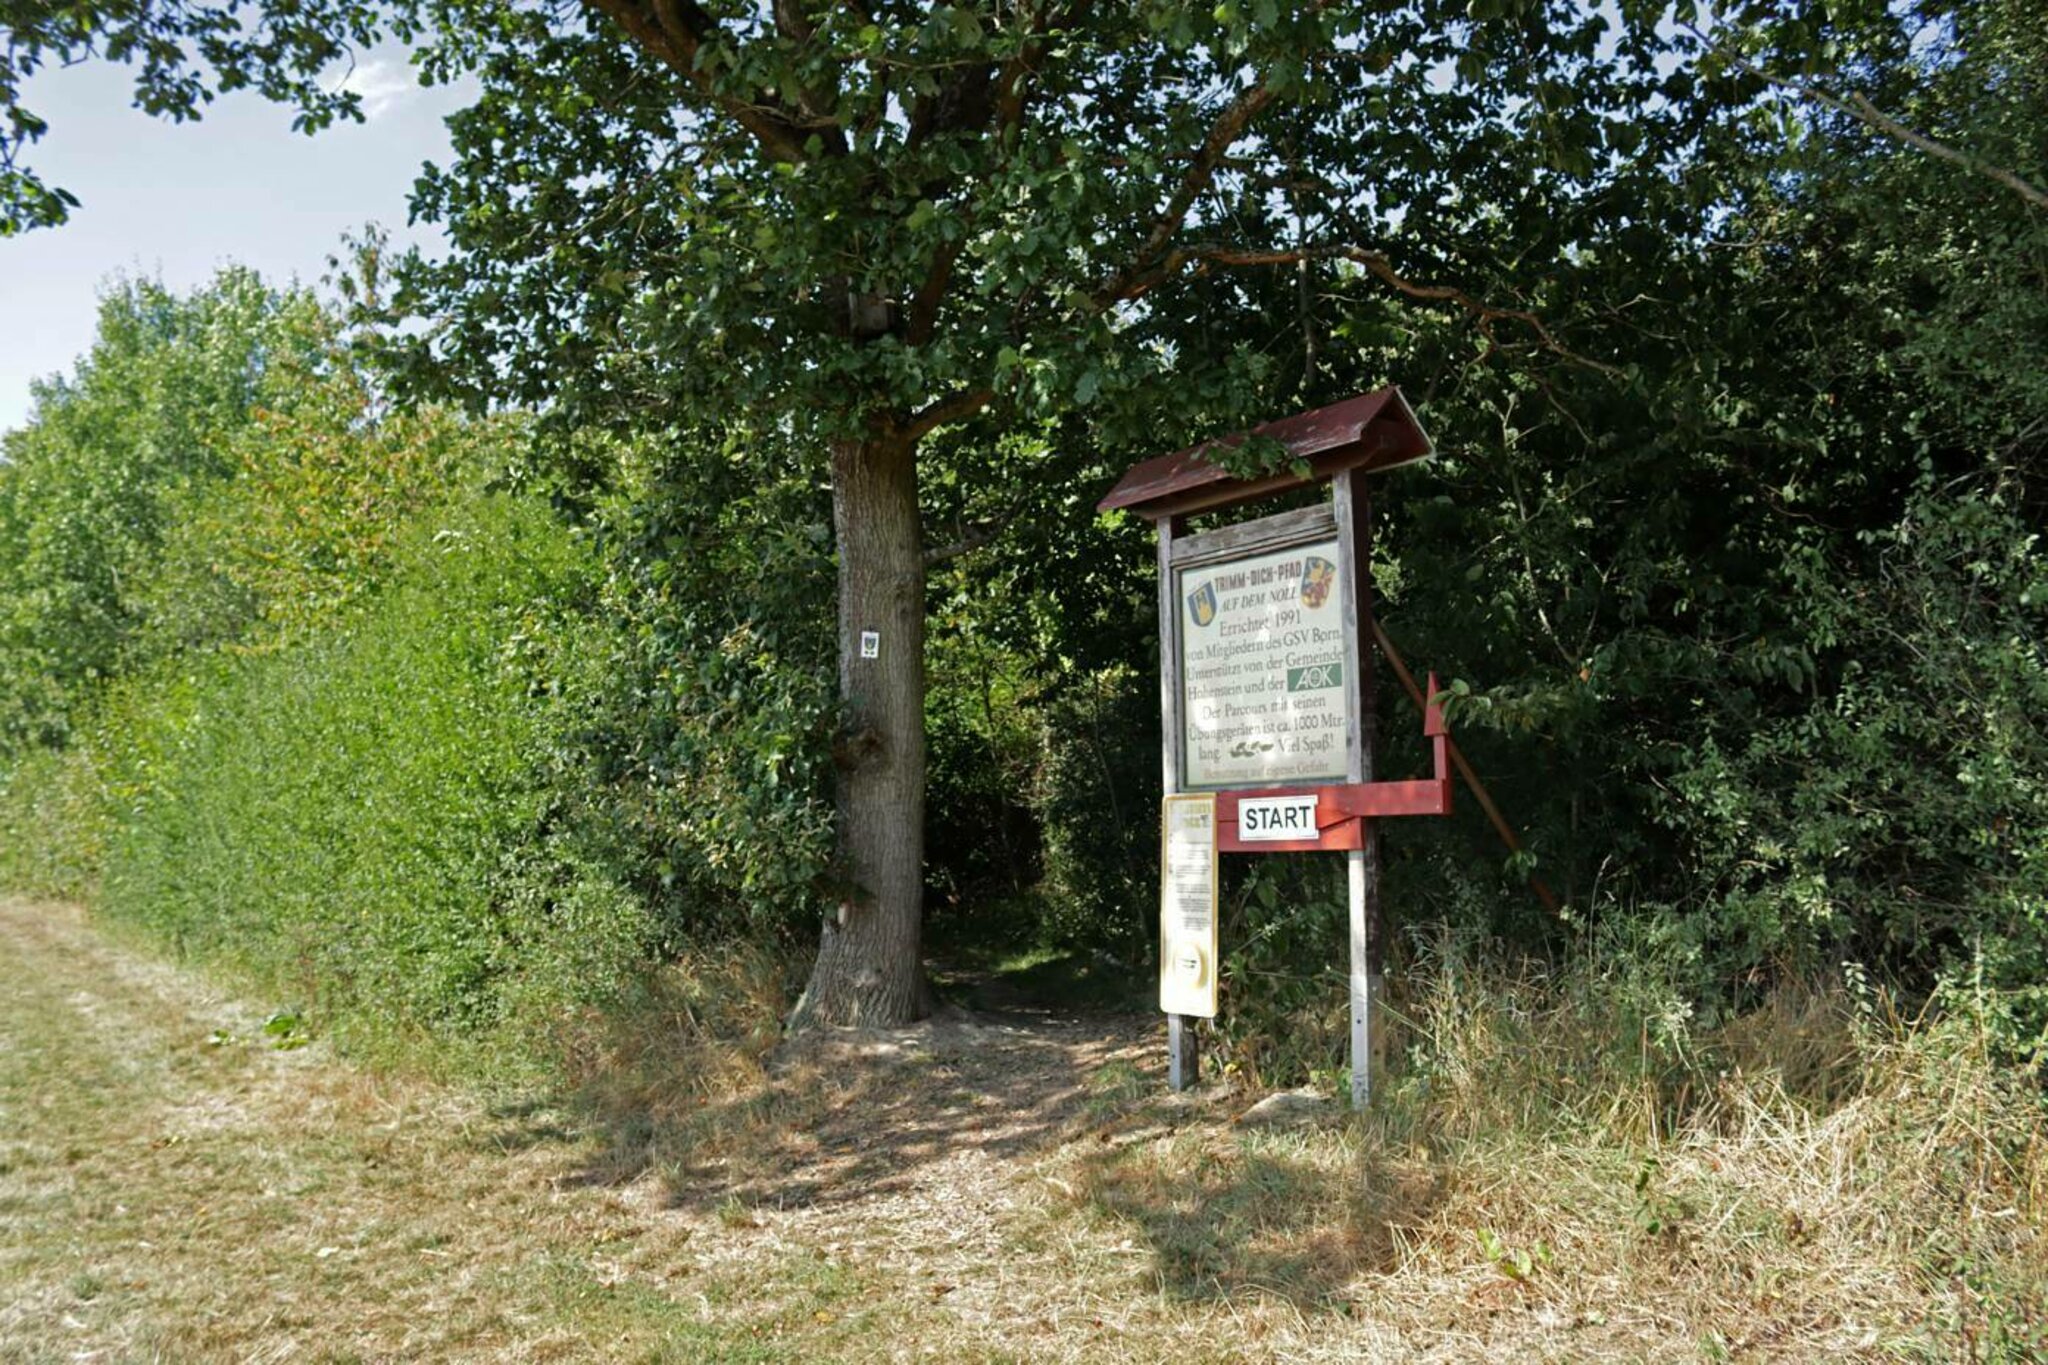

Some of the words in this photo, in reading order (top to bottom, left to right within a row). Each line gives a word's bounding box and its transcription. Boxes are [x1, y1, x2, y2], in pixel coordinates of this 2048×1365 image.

[1214, 561, 1302, 593] TRIMM-DICH-PFAD
[1221, 597, 1239, 613] AUF
[1241, 593, 1265, 609] DEM
[1275, 609, 1301, 628] 1991
[1283, 629, 1310, 646] GSV
[1244, 661, 1263, 674] von
[1267, 656, 1284, 671] der
[1286, 647, 1344, 667] Gemeinde
[1244, 679, 1265, 693] und
[1268, 676, 1285, 691] der
[1295, 666, 1334, 690] AOK
[1225, 702, 1268, 717] Parcours
[1293, 694, 1326, 710] seinen
[1263, 719, 1275, 733] ist
[1277, 721, 1291, 733] ca.
[1294, 715, 1319, 731] 1000
[1245, 806, 1311, 830] START
